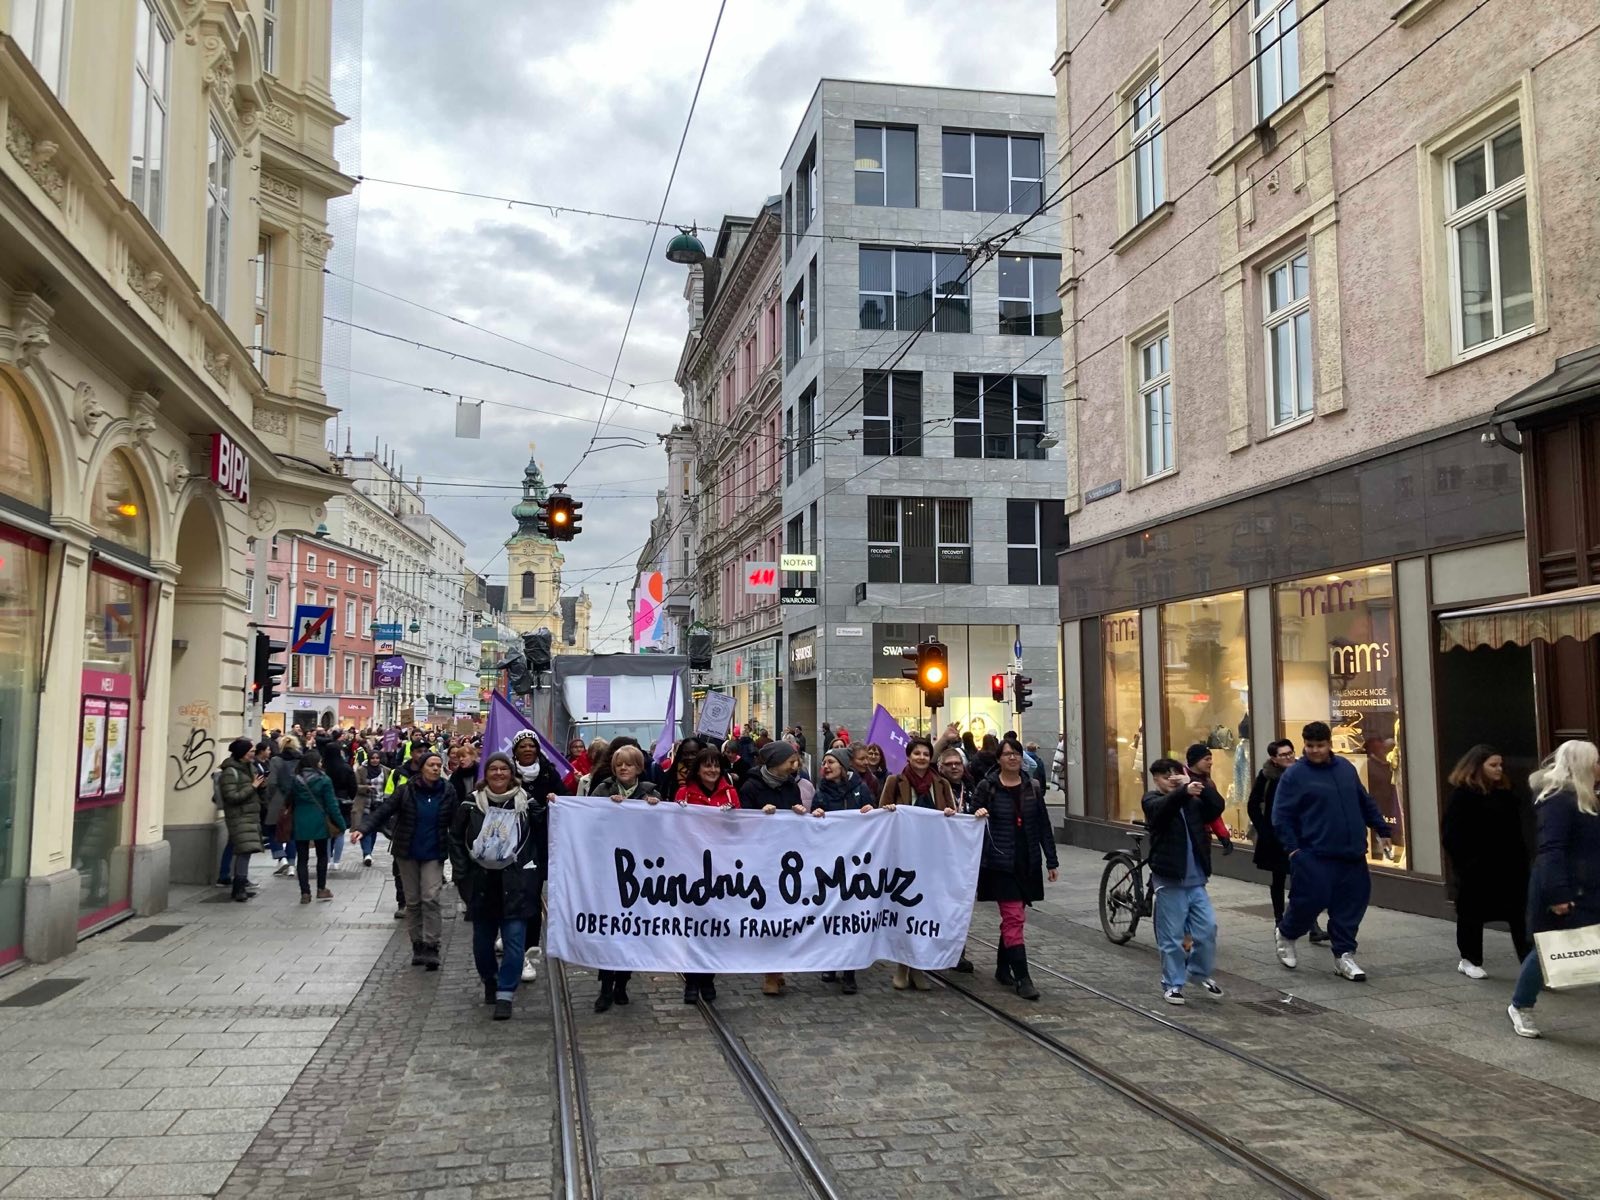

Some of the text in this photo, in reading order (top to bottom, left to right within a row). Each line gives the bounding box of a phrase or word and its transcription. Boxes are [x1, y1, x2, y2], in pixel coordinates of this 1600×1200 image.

[218, 433, 249, 504] BIPA
[1332, 688, 1388, 697] ITALIENISCHE MODE
[1341, 699, 1392, 707] SENSATIONELLEN
[614, 847, 767, 910] Bündnis
[576, 911, 731, 938] OBERÖSTERREICHS
[822, 909, 899, 936] VERBÜNEN
[906, 916, 941, 938] SICH
